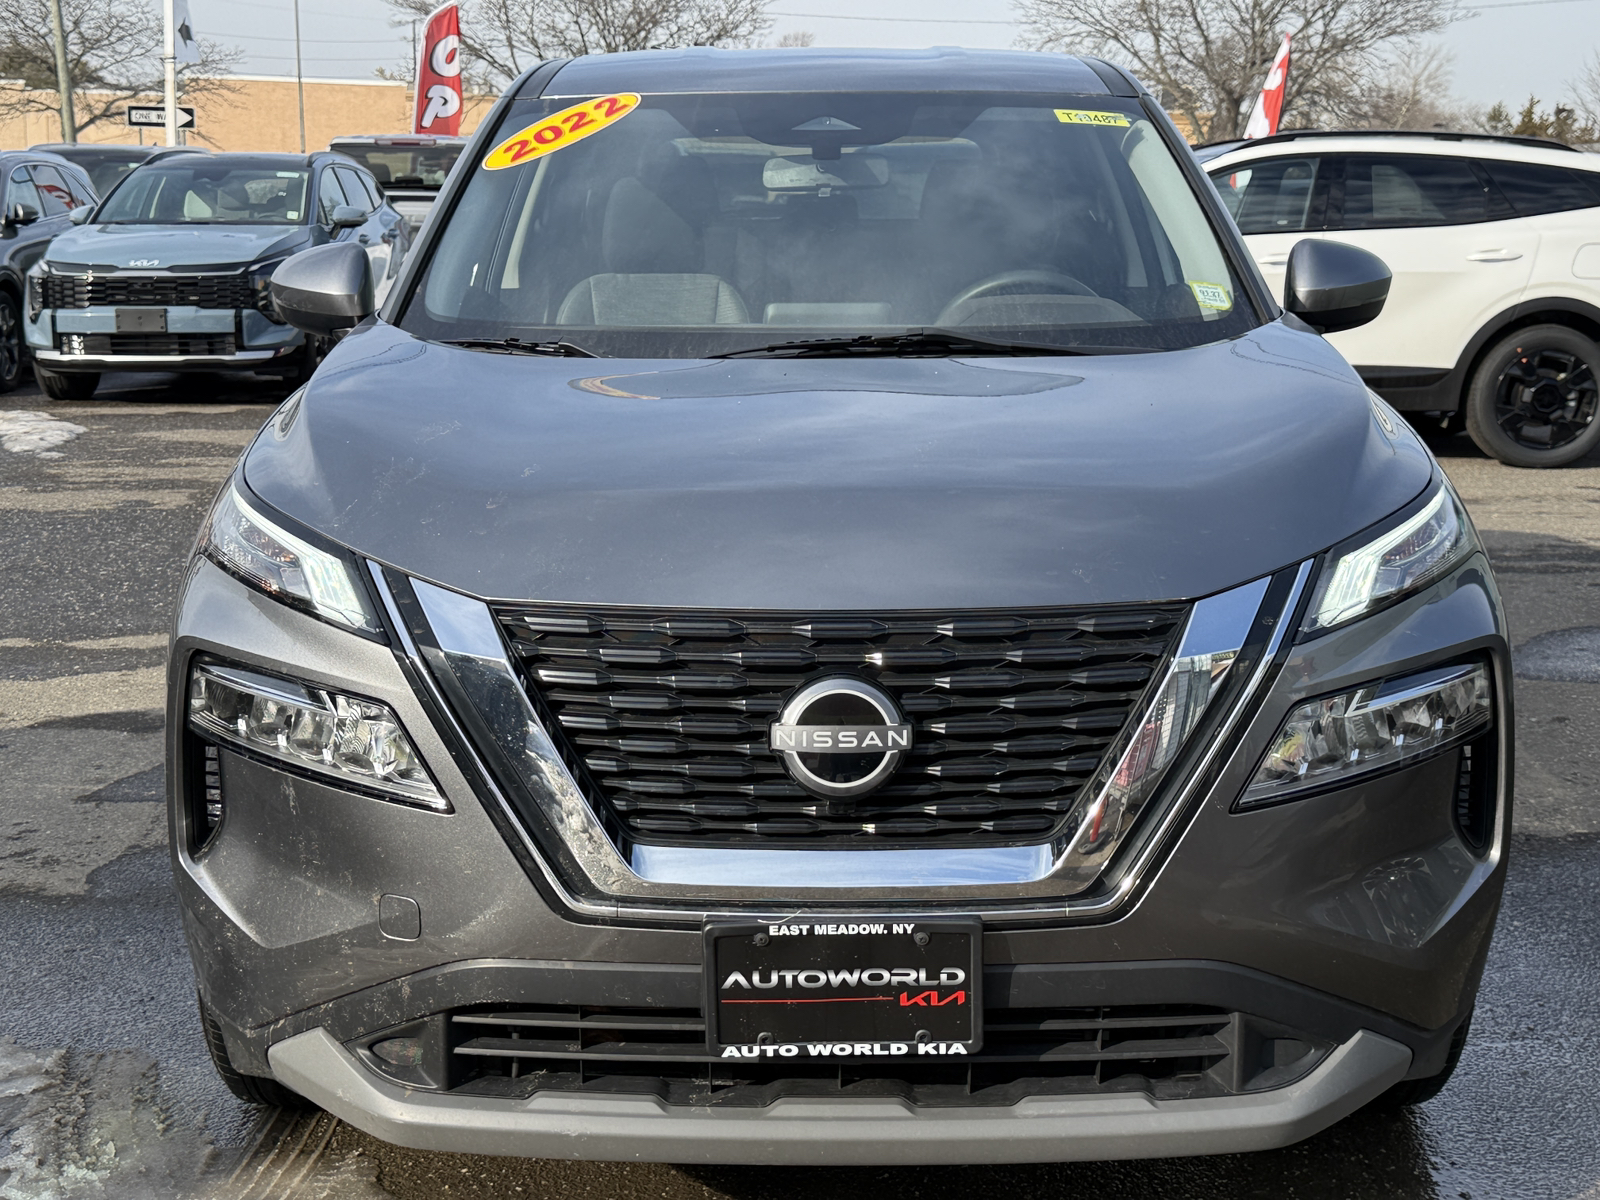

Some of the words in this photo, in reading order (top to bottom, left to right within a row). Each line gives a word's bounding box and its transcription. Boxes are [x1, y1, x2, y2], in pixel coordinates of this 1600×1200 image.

[503, 96, 630, 163] 2022
[129, 259, 160, 267] KIA
[775, 729, 908, 748] NISSAN
[769, 924, 810, 936] EAST
[892, 923, 915, 935] NY
[721, 967, 966, 990] AUTOWORLD
[899, 990, 966, 1007] KIA
[721, 1044, 799, 1058] AUTO
[805, 1043, 910, 1056] WORLD
[918, 1043, 968, 1055] KIA
